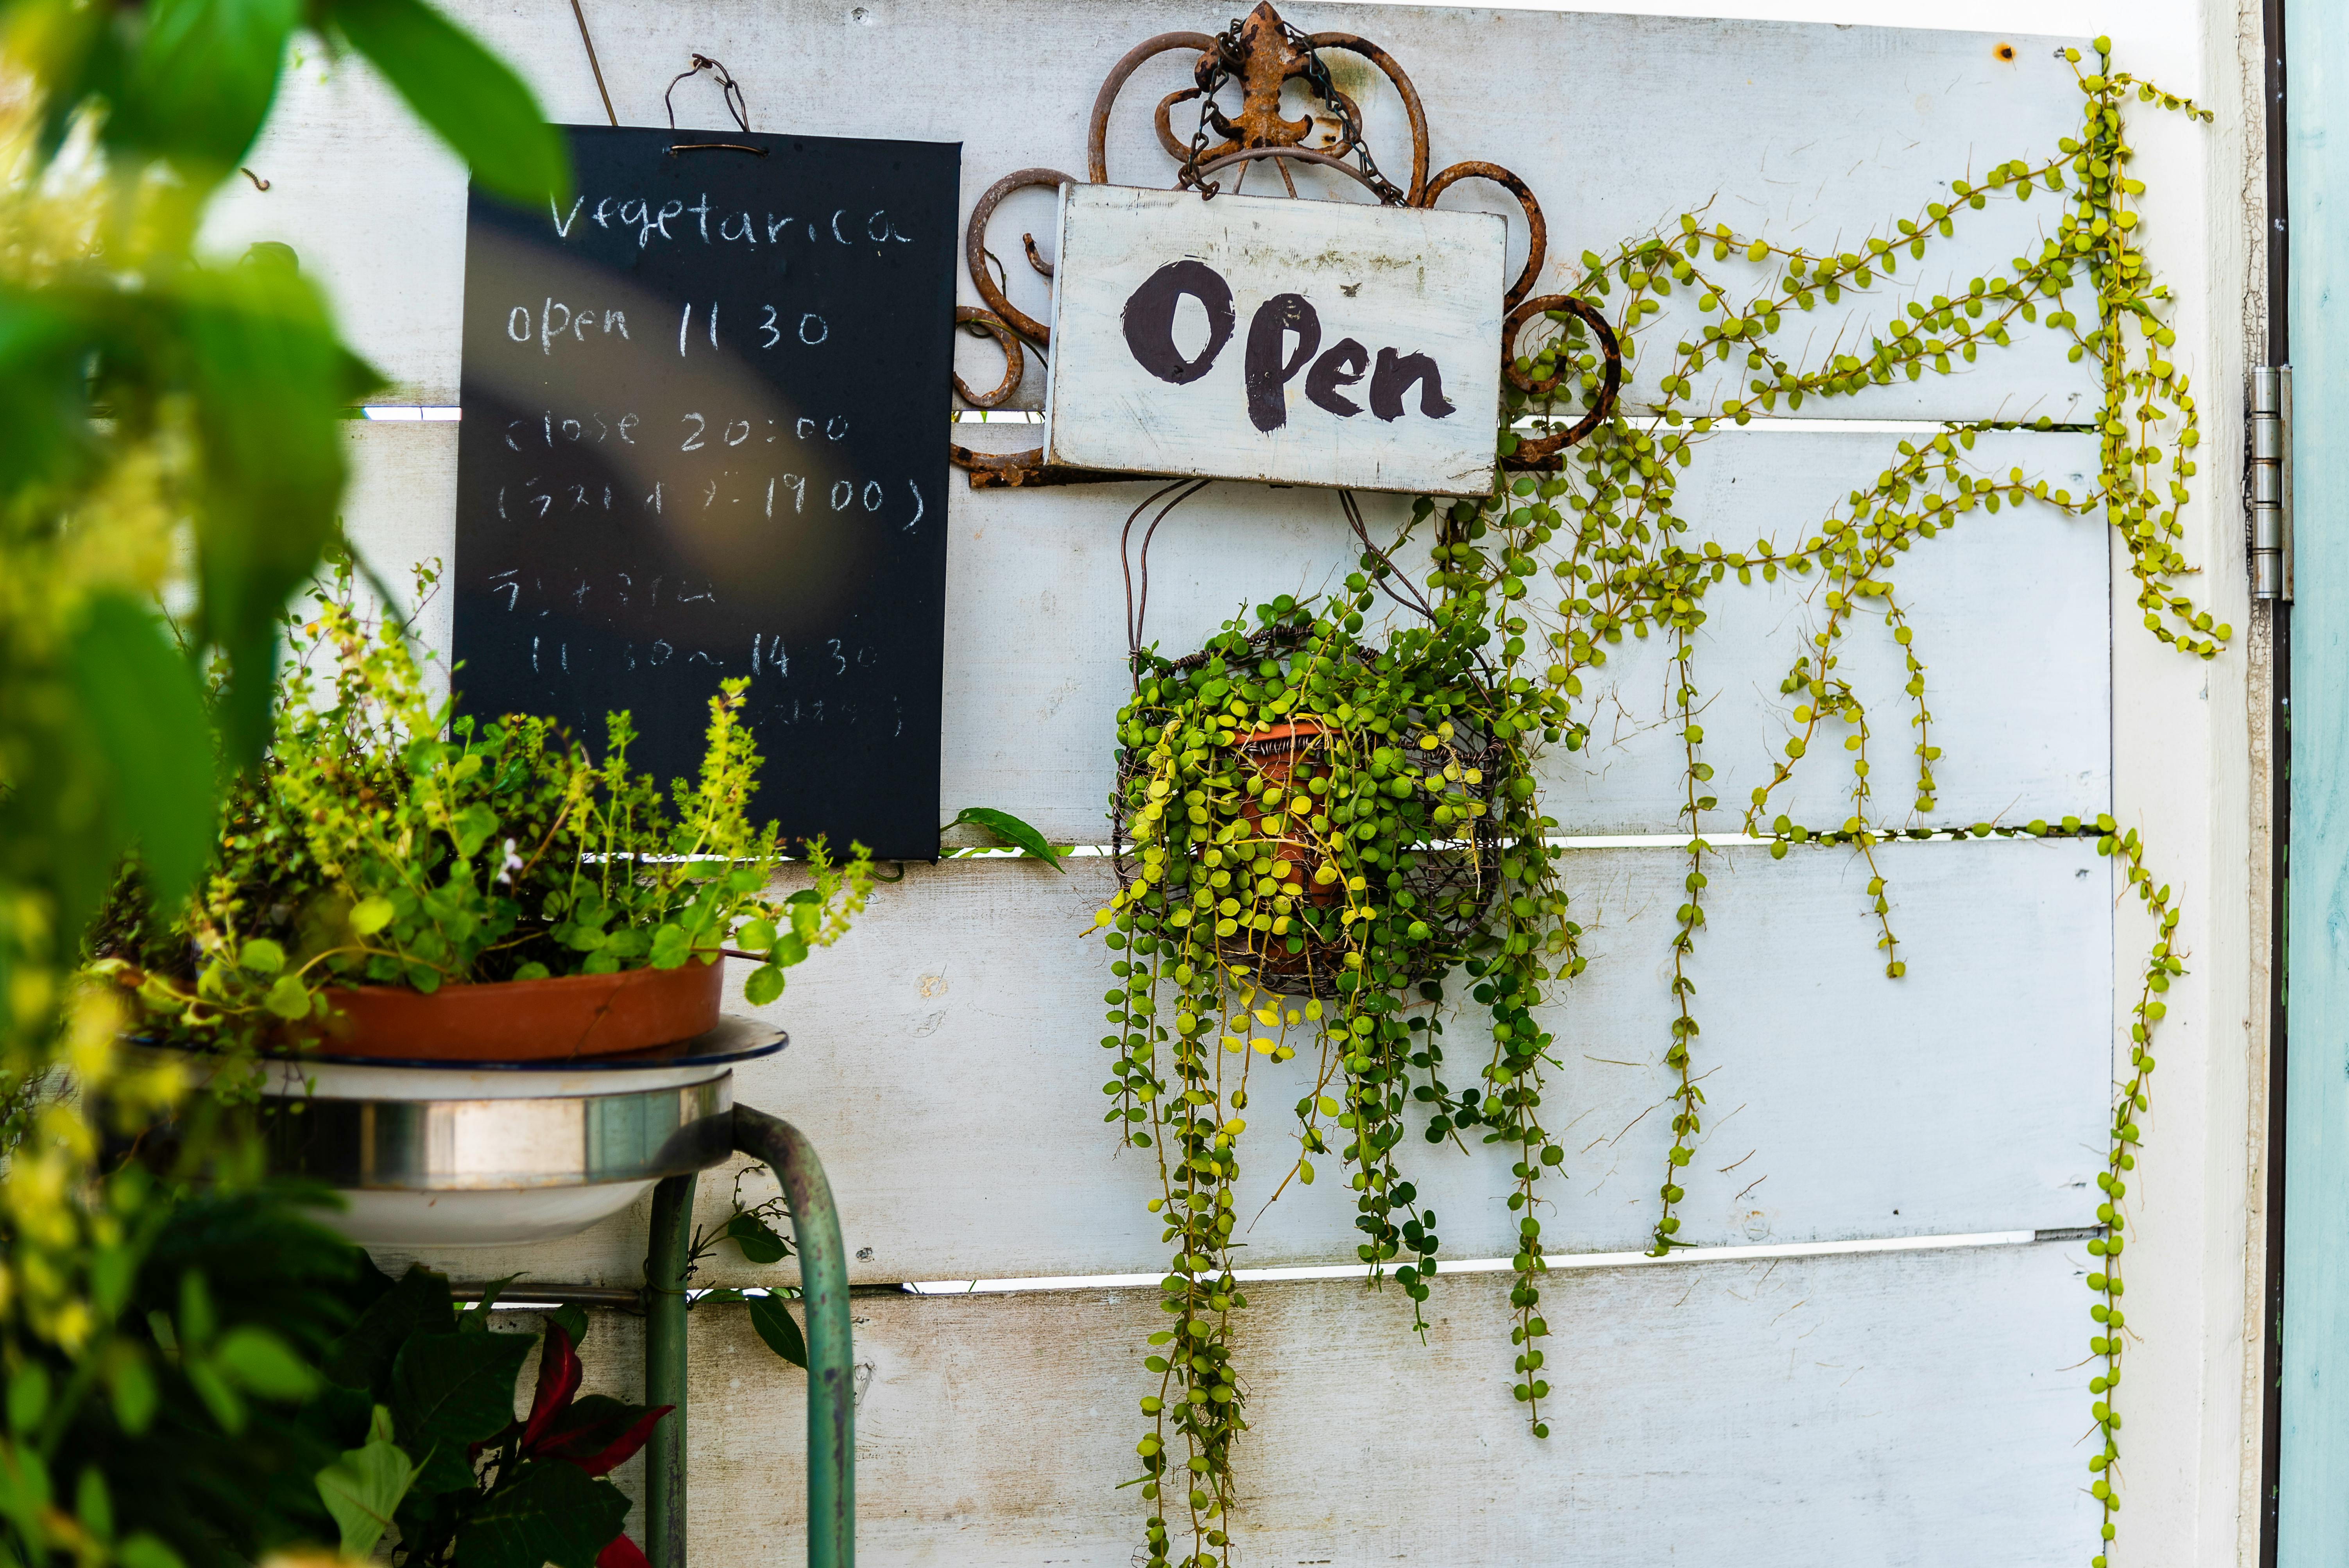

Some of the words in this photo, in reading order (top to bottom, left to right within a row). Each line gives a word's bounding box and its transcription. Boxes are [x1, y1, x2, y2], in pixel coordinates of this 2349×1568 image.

[1120, 255, 1457, 436] Open
[505, 410, 639, 451] close
[680, 412, 849, 452] 20:00
